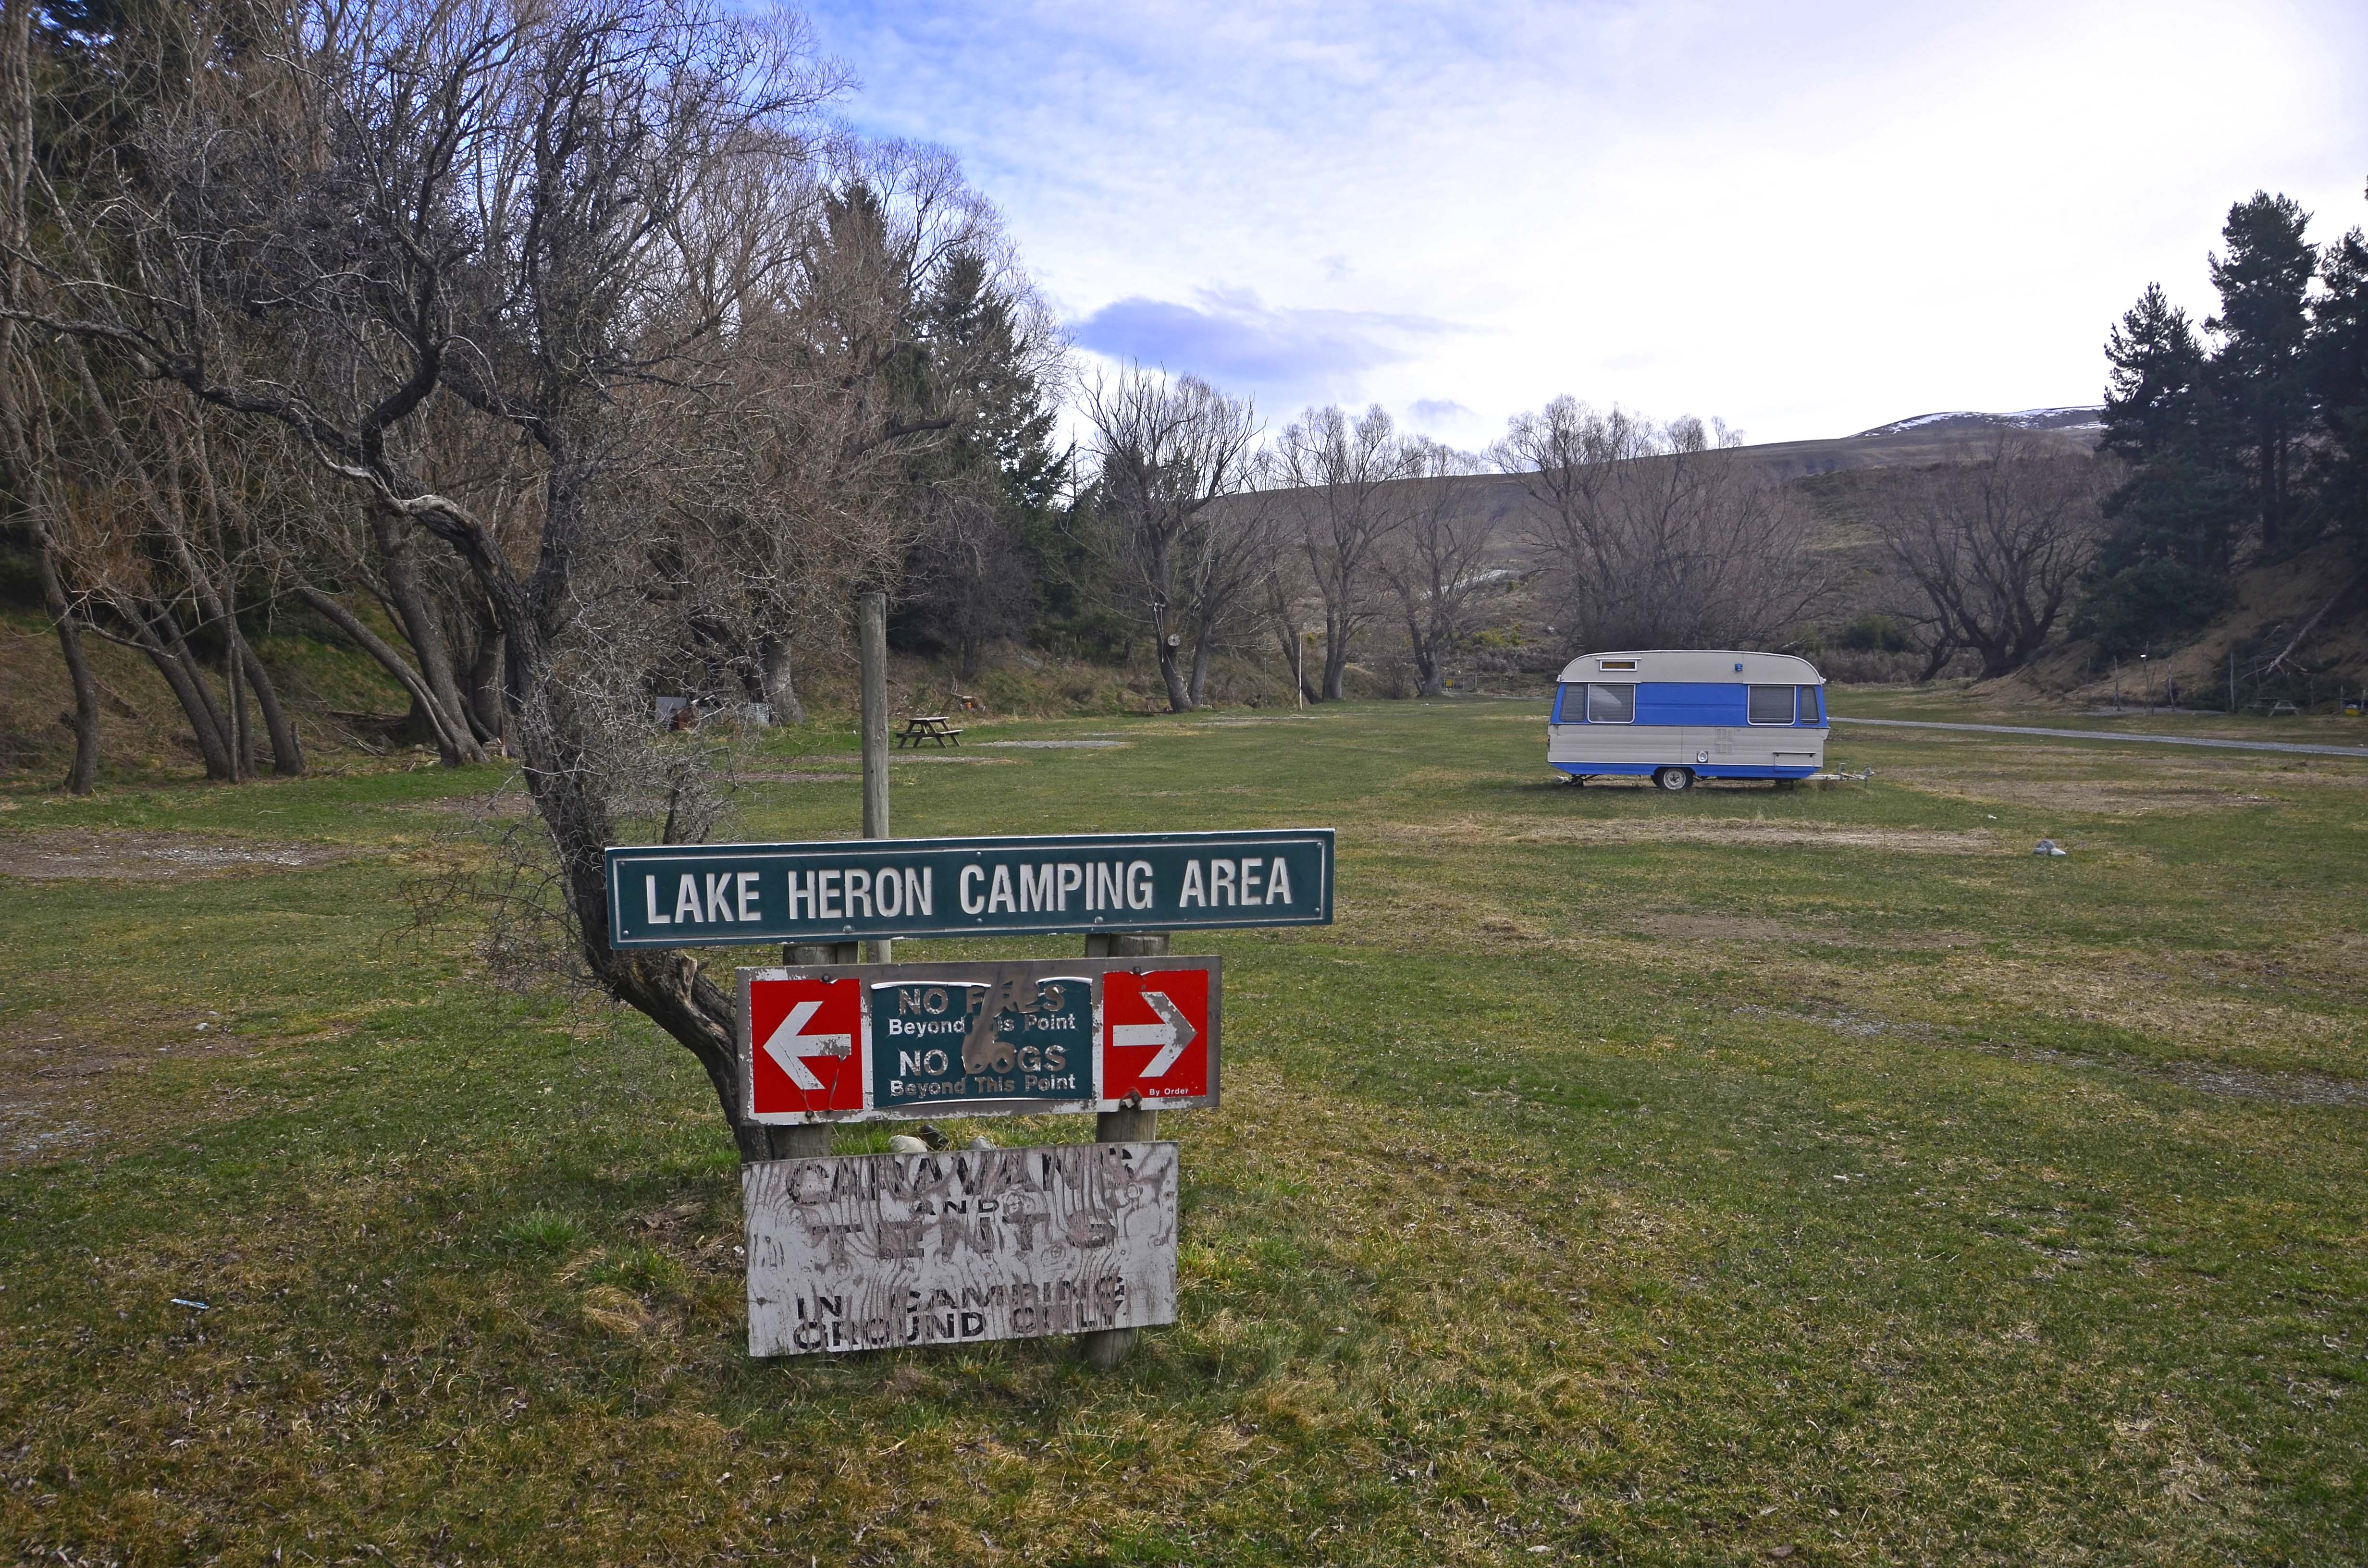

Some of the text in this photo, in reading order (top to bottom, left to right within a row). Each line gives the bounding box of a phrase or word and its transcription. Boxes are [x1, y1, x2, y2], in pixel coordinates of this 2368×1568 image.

[646, 857, 1293, 923] LAKE HERON CAMPING AREA
[899, 988, 949, 1015] NO
[889, 1015, 965, 1038] Beyond
[1024, 1013, 1076, 1031] Point
[899, 1049, 949, 1077] NO
[890, 1073, 1076, 1099] Beyond This Point
[797, 1295, 842, 1320] IN
